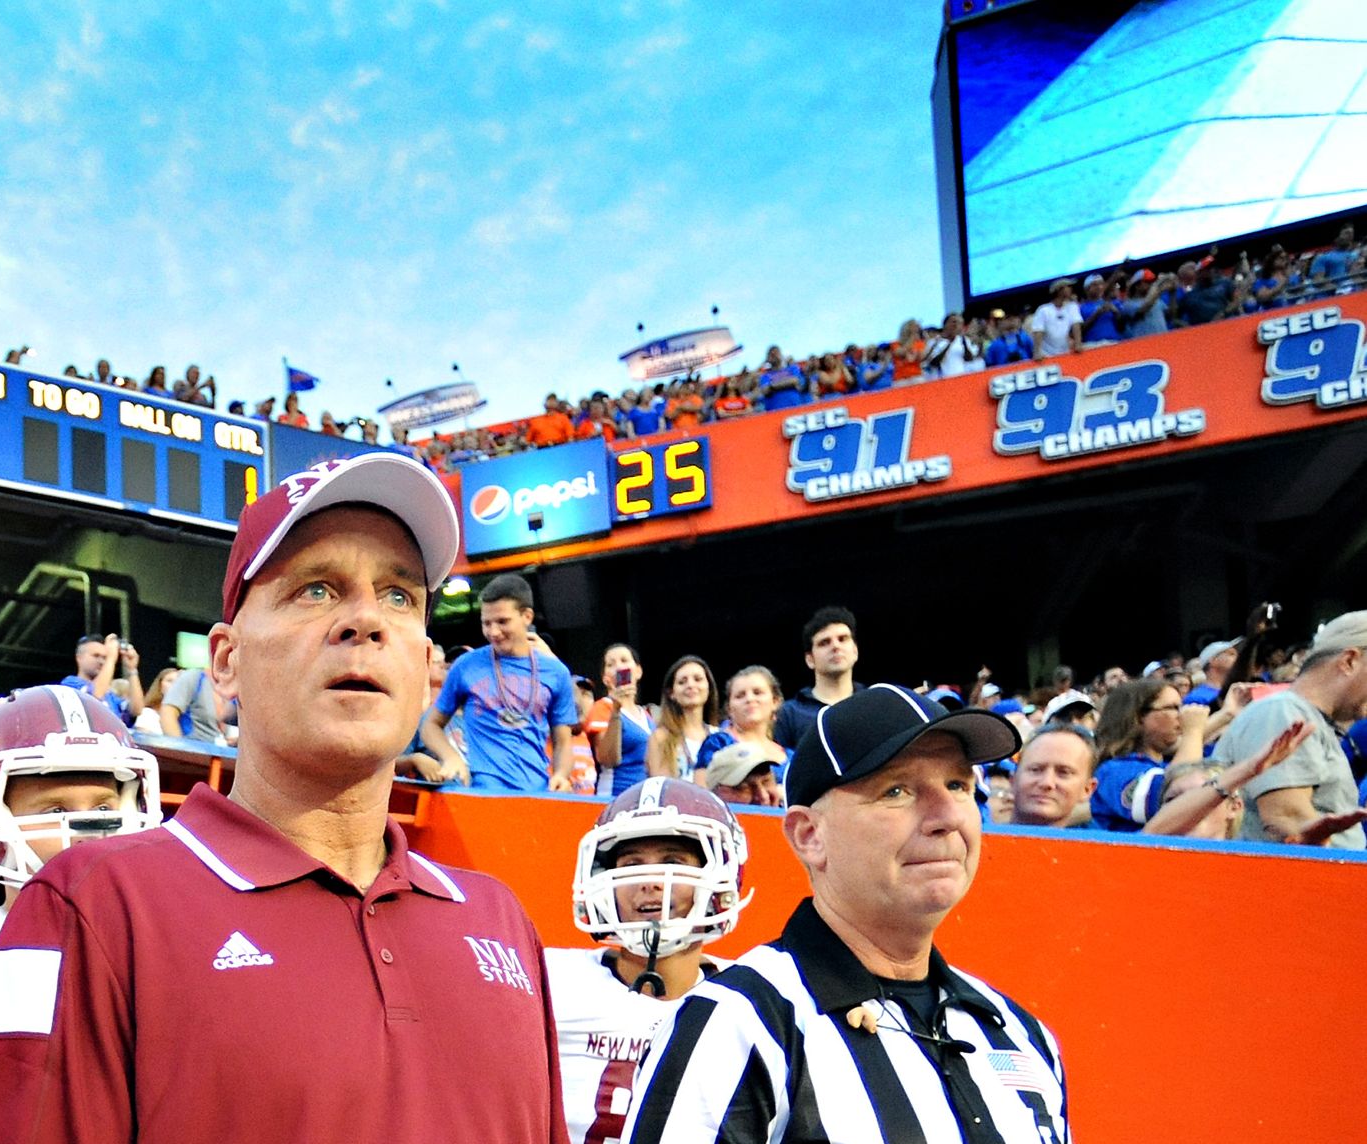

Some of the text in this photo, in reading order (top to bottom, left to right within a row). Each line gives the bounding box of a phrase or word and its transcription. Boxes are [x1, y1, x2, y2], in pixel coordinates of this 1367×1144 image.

[1259, 305, 1339, 342] SEC
[990, 366, 1062, 396] SEC
[1262, 320, 1367, 402] 9
[28, 380, 101, 420] TO GO
[119, 400, 202, 442] BALL ON
[994, 360, 1169, 452] 93
[784, 408, 847, 437] SEC
[1042, 408, 1205, 458] CHAMPS
[787, 408, 914, 491] 91
[512, 471, 596, 516] pepsi
[615, 440, 707, 515] 25
[805, 455, 952, 500] CHAMPS
[212, 952, 275, 971] adidas
[463, 935, 528, 978] NM
[478, 964, 534, 996] STATE
[586, 1032, 624, 1060] NEW
